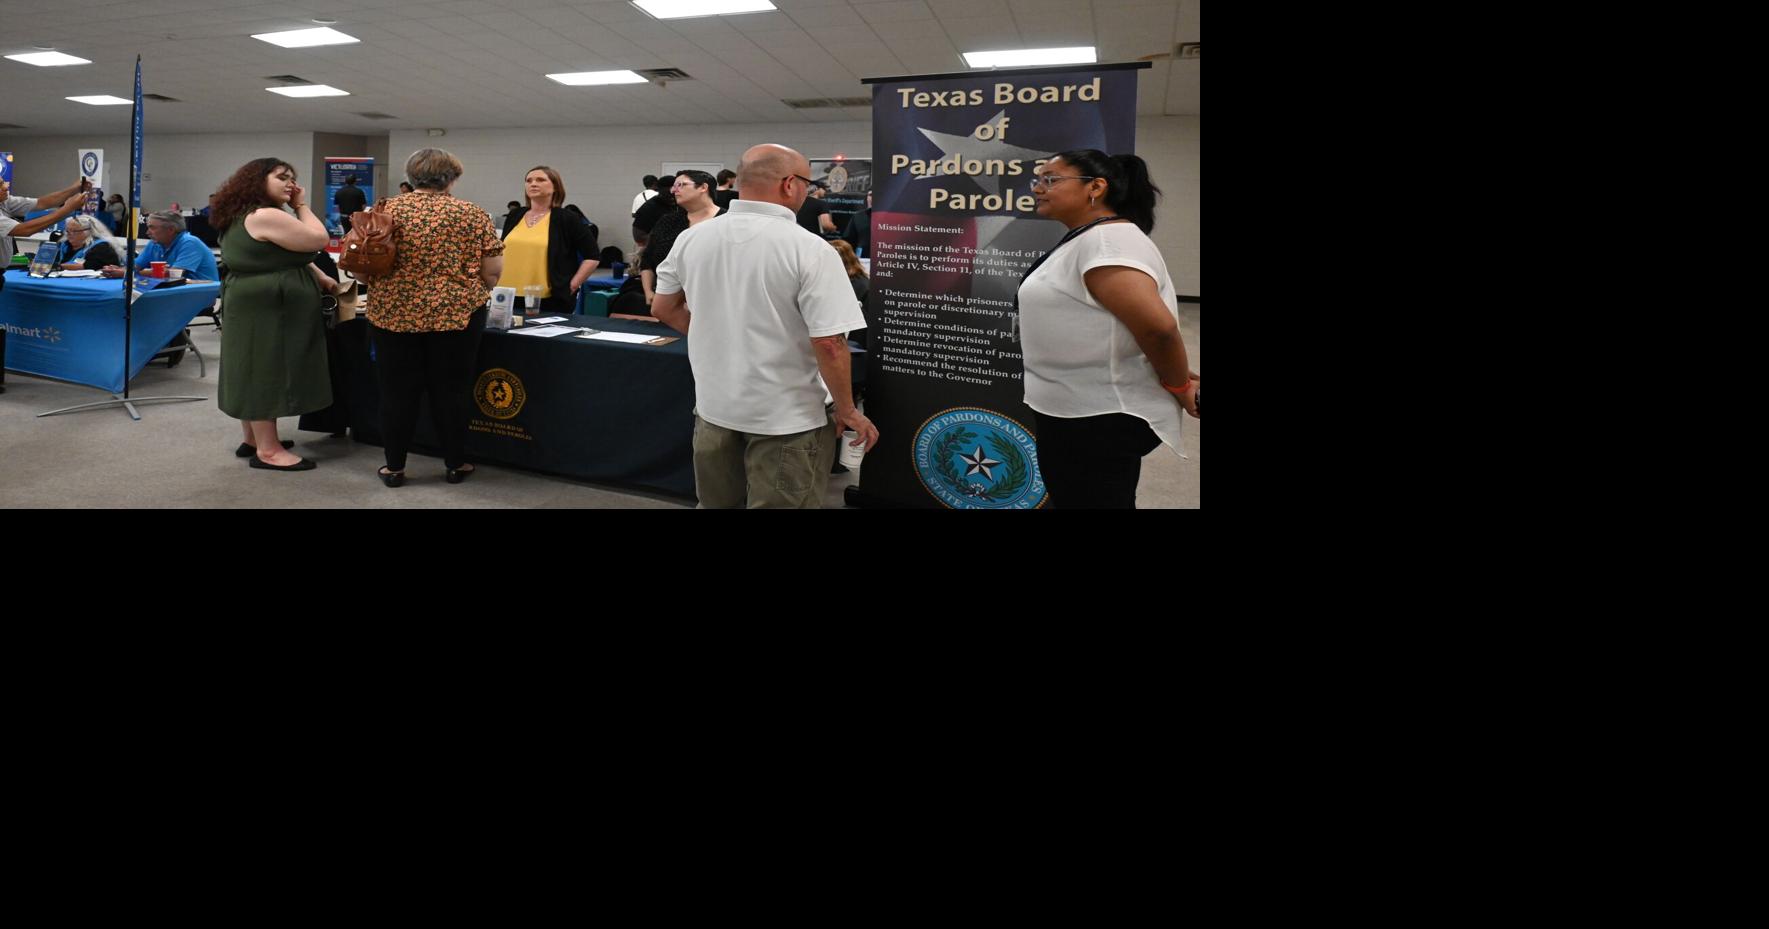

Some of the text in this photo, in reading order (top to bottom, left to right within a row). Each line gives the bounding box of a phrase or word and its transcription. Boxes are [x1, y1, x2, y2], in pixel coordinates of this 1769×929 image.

[897, 78, 1100, 108] Texas Board
[974, 117, 1010, 141] of
[891, 153, 1023, 176] Pardons
[930, 188, 1036, 212] Parole
[878, 223, 964, 234] Mission Statement:
[876, 252, 906, 260] Paroles
[909, 252, 918, 260] is
[932, 255, 970, 265] perform
[986, 258, 1018, 267] duties
[877, 242, 892, 250] The
[894, 243, 931, 252] mission
[945, 246, 960, 254] the
[962, 246, 986, 255] Texas
[992, 248, 1022, 257] Board
[876, 260, 1024, 278] Article IV, Section 11, of the Tex
[884, 288, 1014, 308] Determine which prisoners
[884, 308, 937, 320] supervision
[898, 300, 926, 310] parole
[940, 302, 1004, 318] discretionary
[0, 322, 40, 338] almart
[883, 327, 932, 340] mandatory
[934, 333, 991, 345] supervision
[884, 316, 932, 329] Determine
[934, 323, 984, 335] conditions
[986, 328, 998, 336] of
[882, 346, 990, 366] mandatory supervision
[883, 335, 1022, 360] Determine revocation of paro
[882, 354, 1022, 380] Recommend the resolution of
[882, 364, 915, 375] matters
[928, 370, 944, 379] the
[946, 372, 992, 386] Governor
[919, 433, 932, 468] BOARD
[928, 422, 942, 434] OF
[941, 412, 1002, 427] PARDONS
[1001, 423, 1028, 444] AND
[928, 477, 963, 506] STATE
